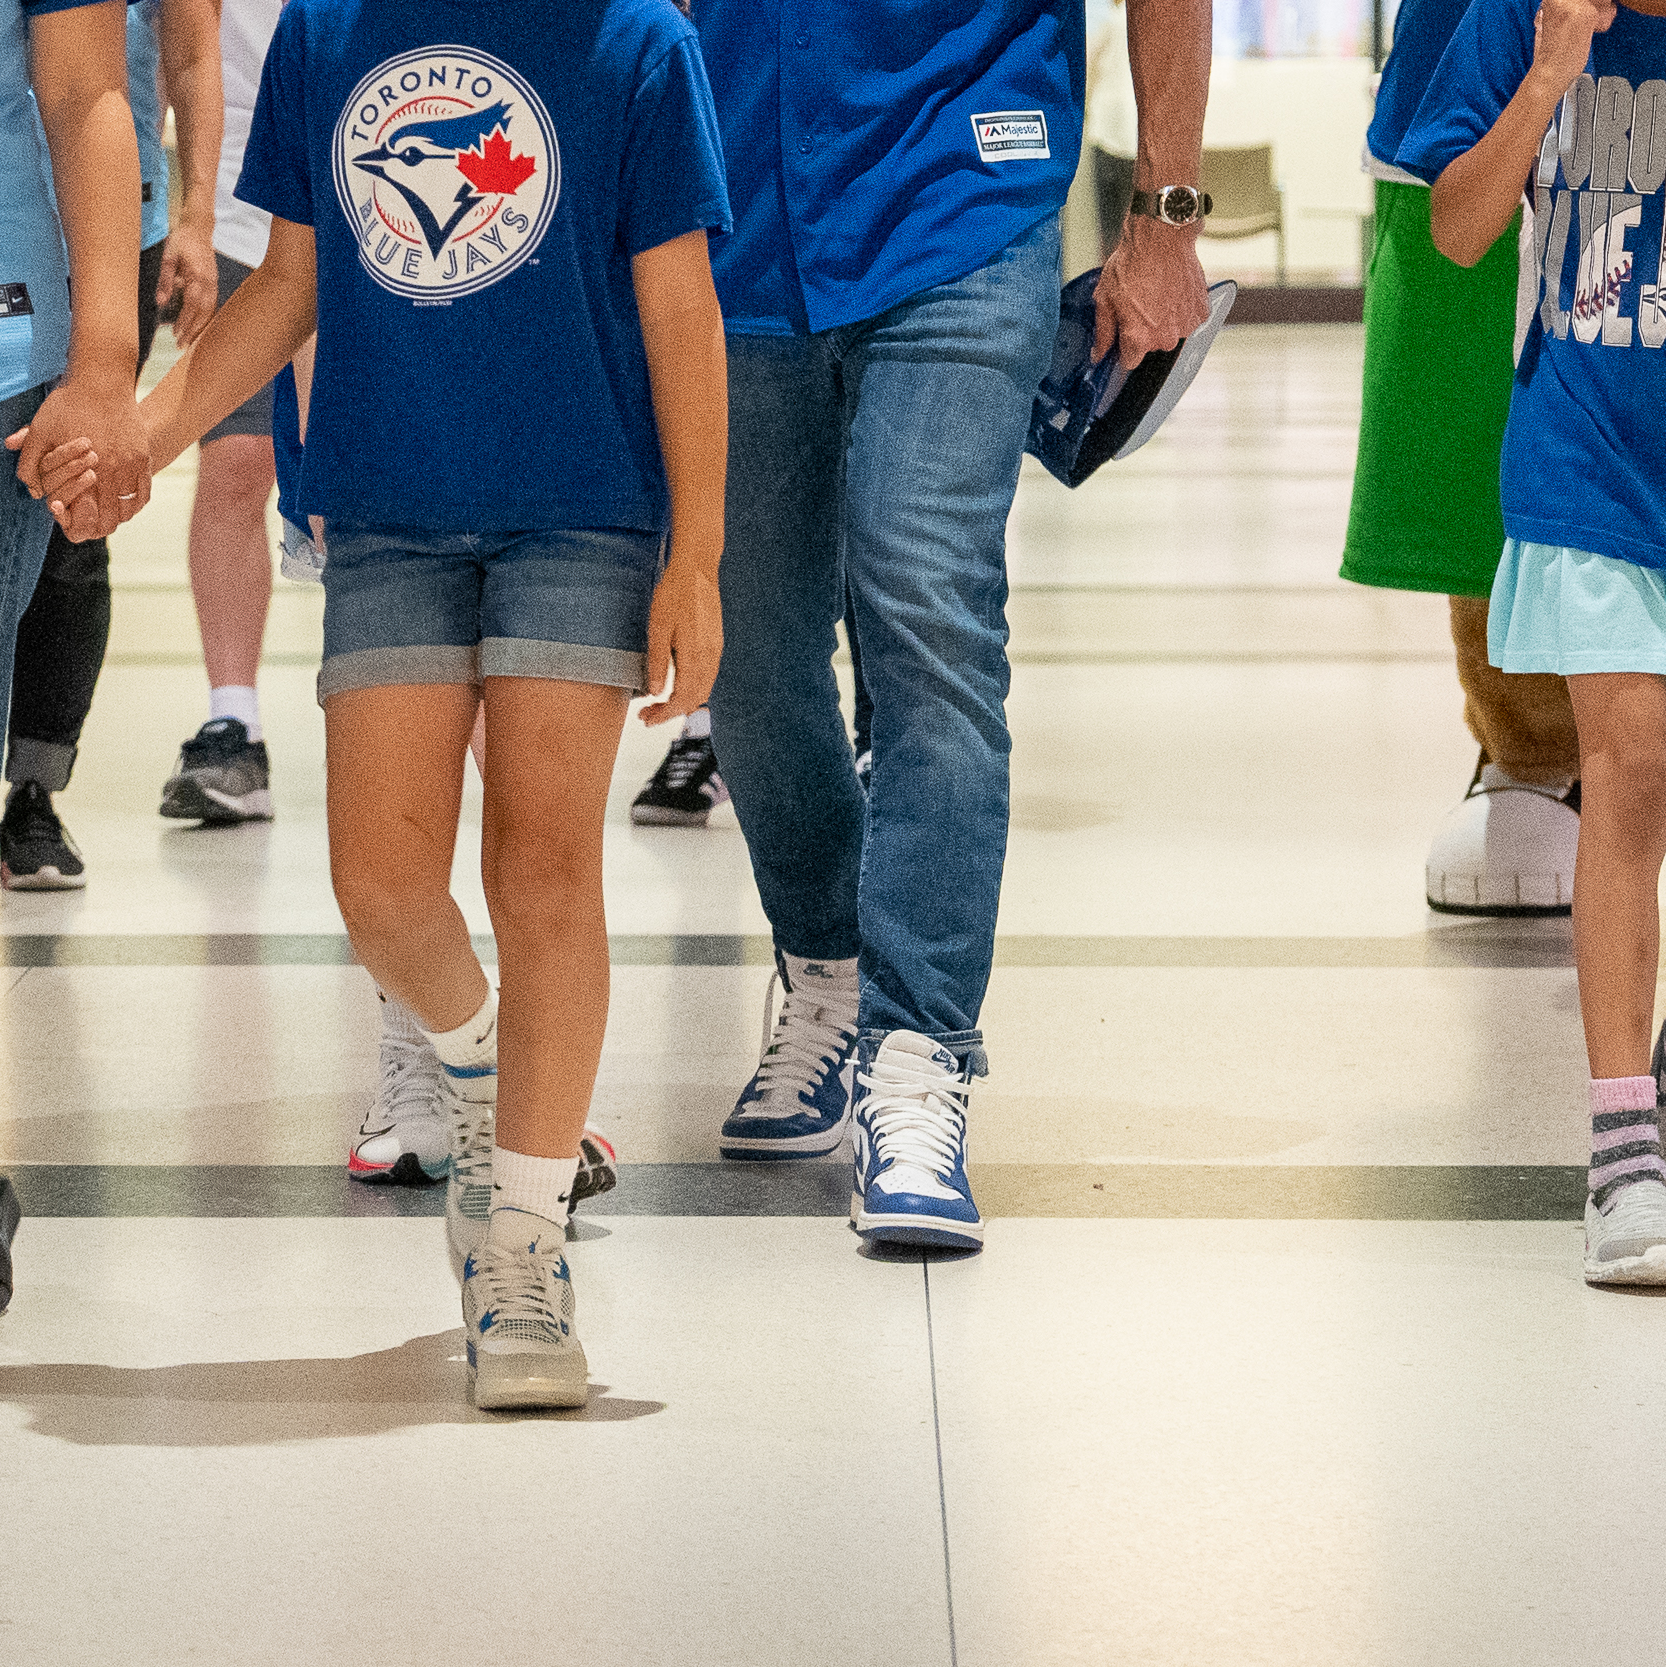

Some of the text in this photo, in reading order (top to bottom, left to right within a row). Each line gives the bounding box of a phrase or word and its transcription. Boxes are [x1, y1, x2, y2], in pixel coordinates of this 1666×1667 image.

[350, 65, 493, 143] TORONTO
[1000, 123, 1039, 138] Majestic
[359, 197, 530, 281] BLUE JAYS
